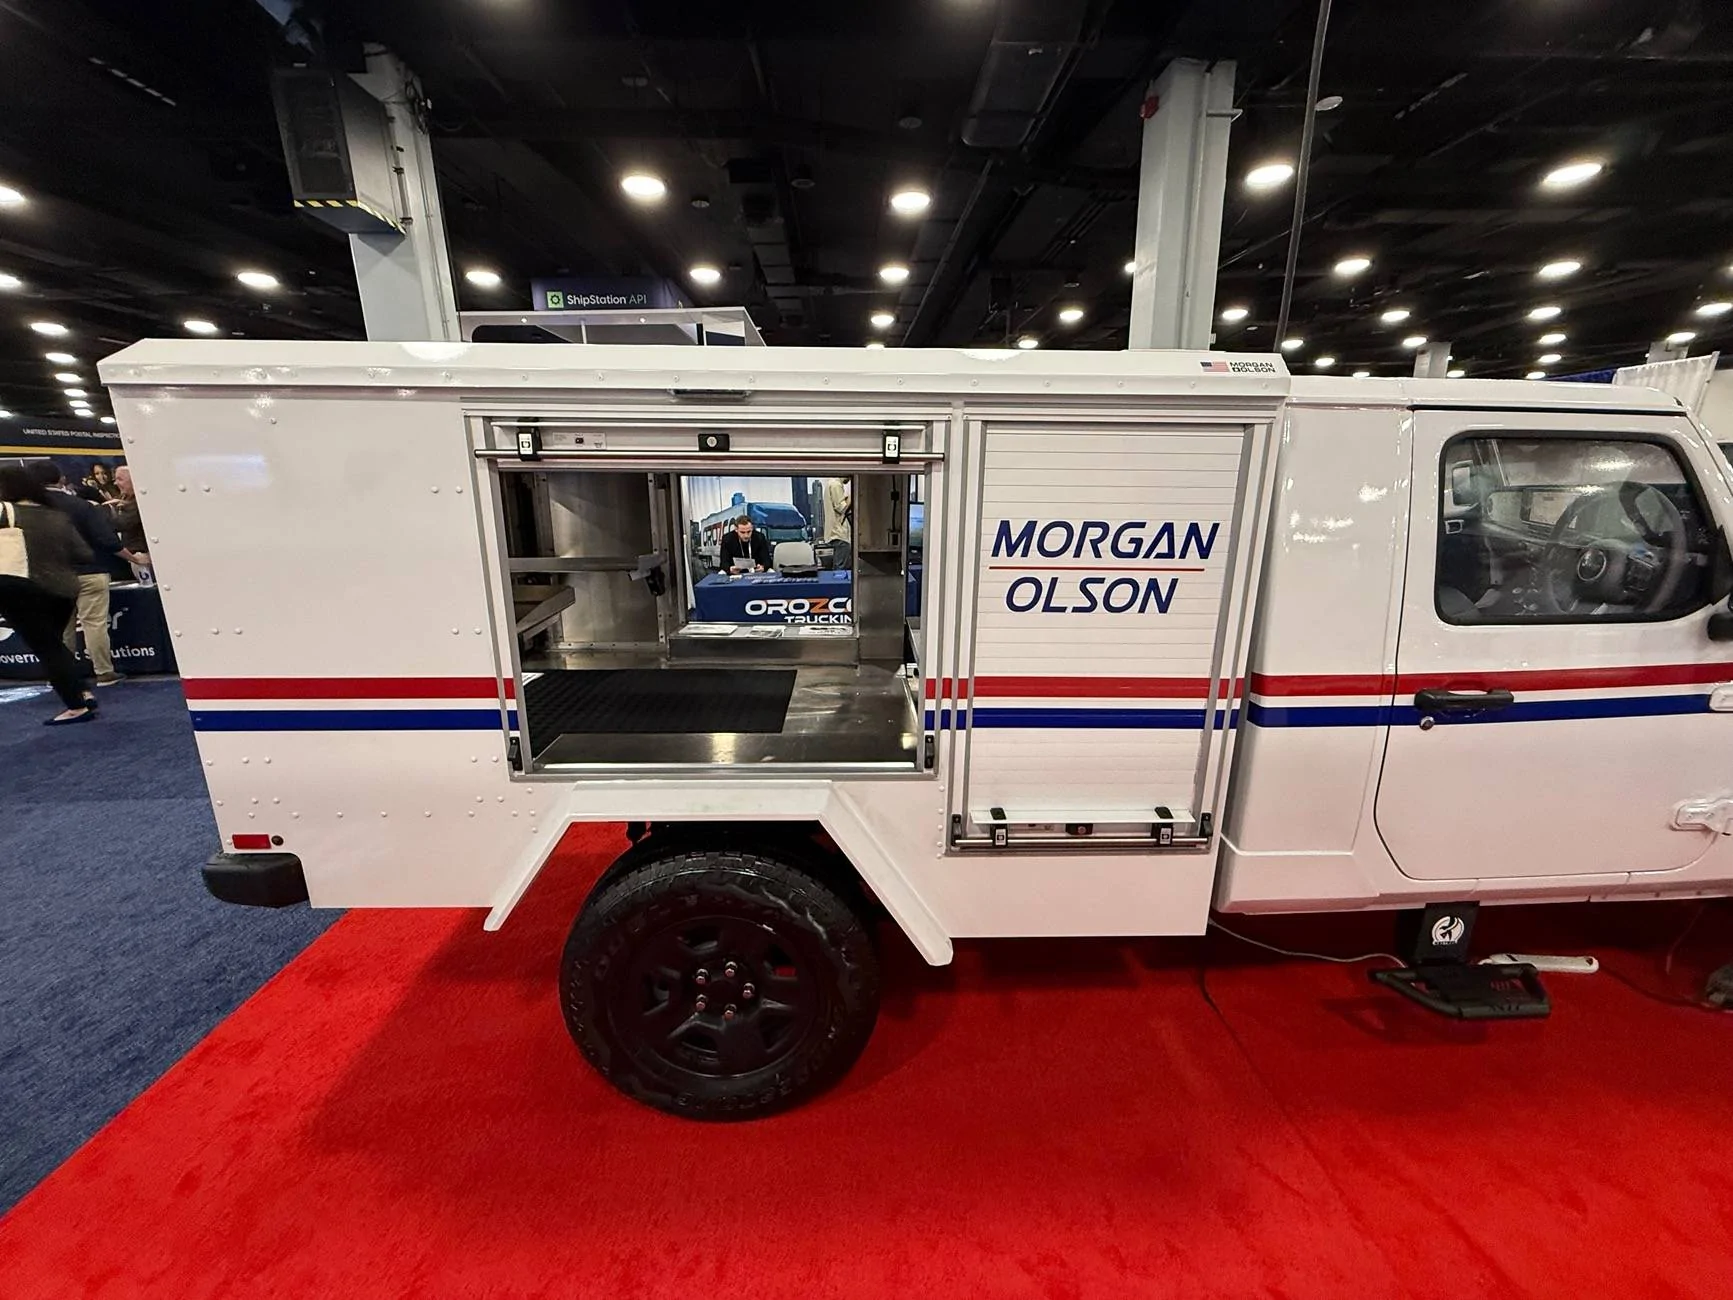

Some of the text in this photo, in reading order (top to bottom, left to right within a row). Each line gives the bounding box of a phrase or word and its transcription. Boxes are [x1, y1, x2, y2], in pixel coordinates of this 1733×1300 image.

[567, 294, 647, 307] ShipStation API
[71, 430, 92, 438] POSTAL
[991, 520, 1220, 560] MORGAN
[1006, 576, 1179, 614] OLSON
